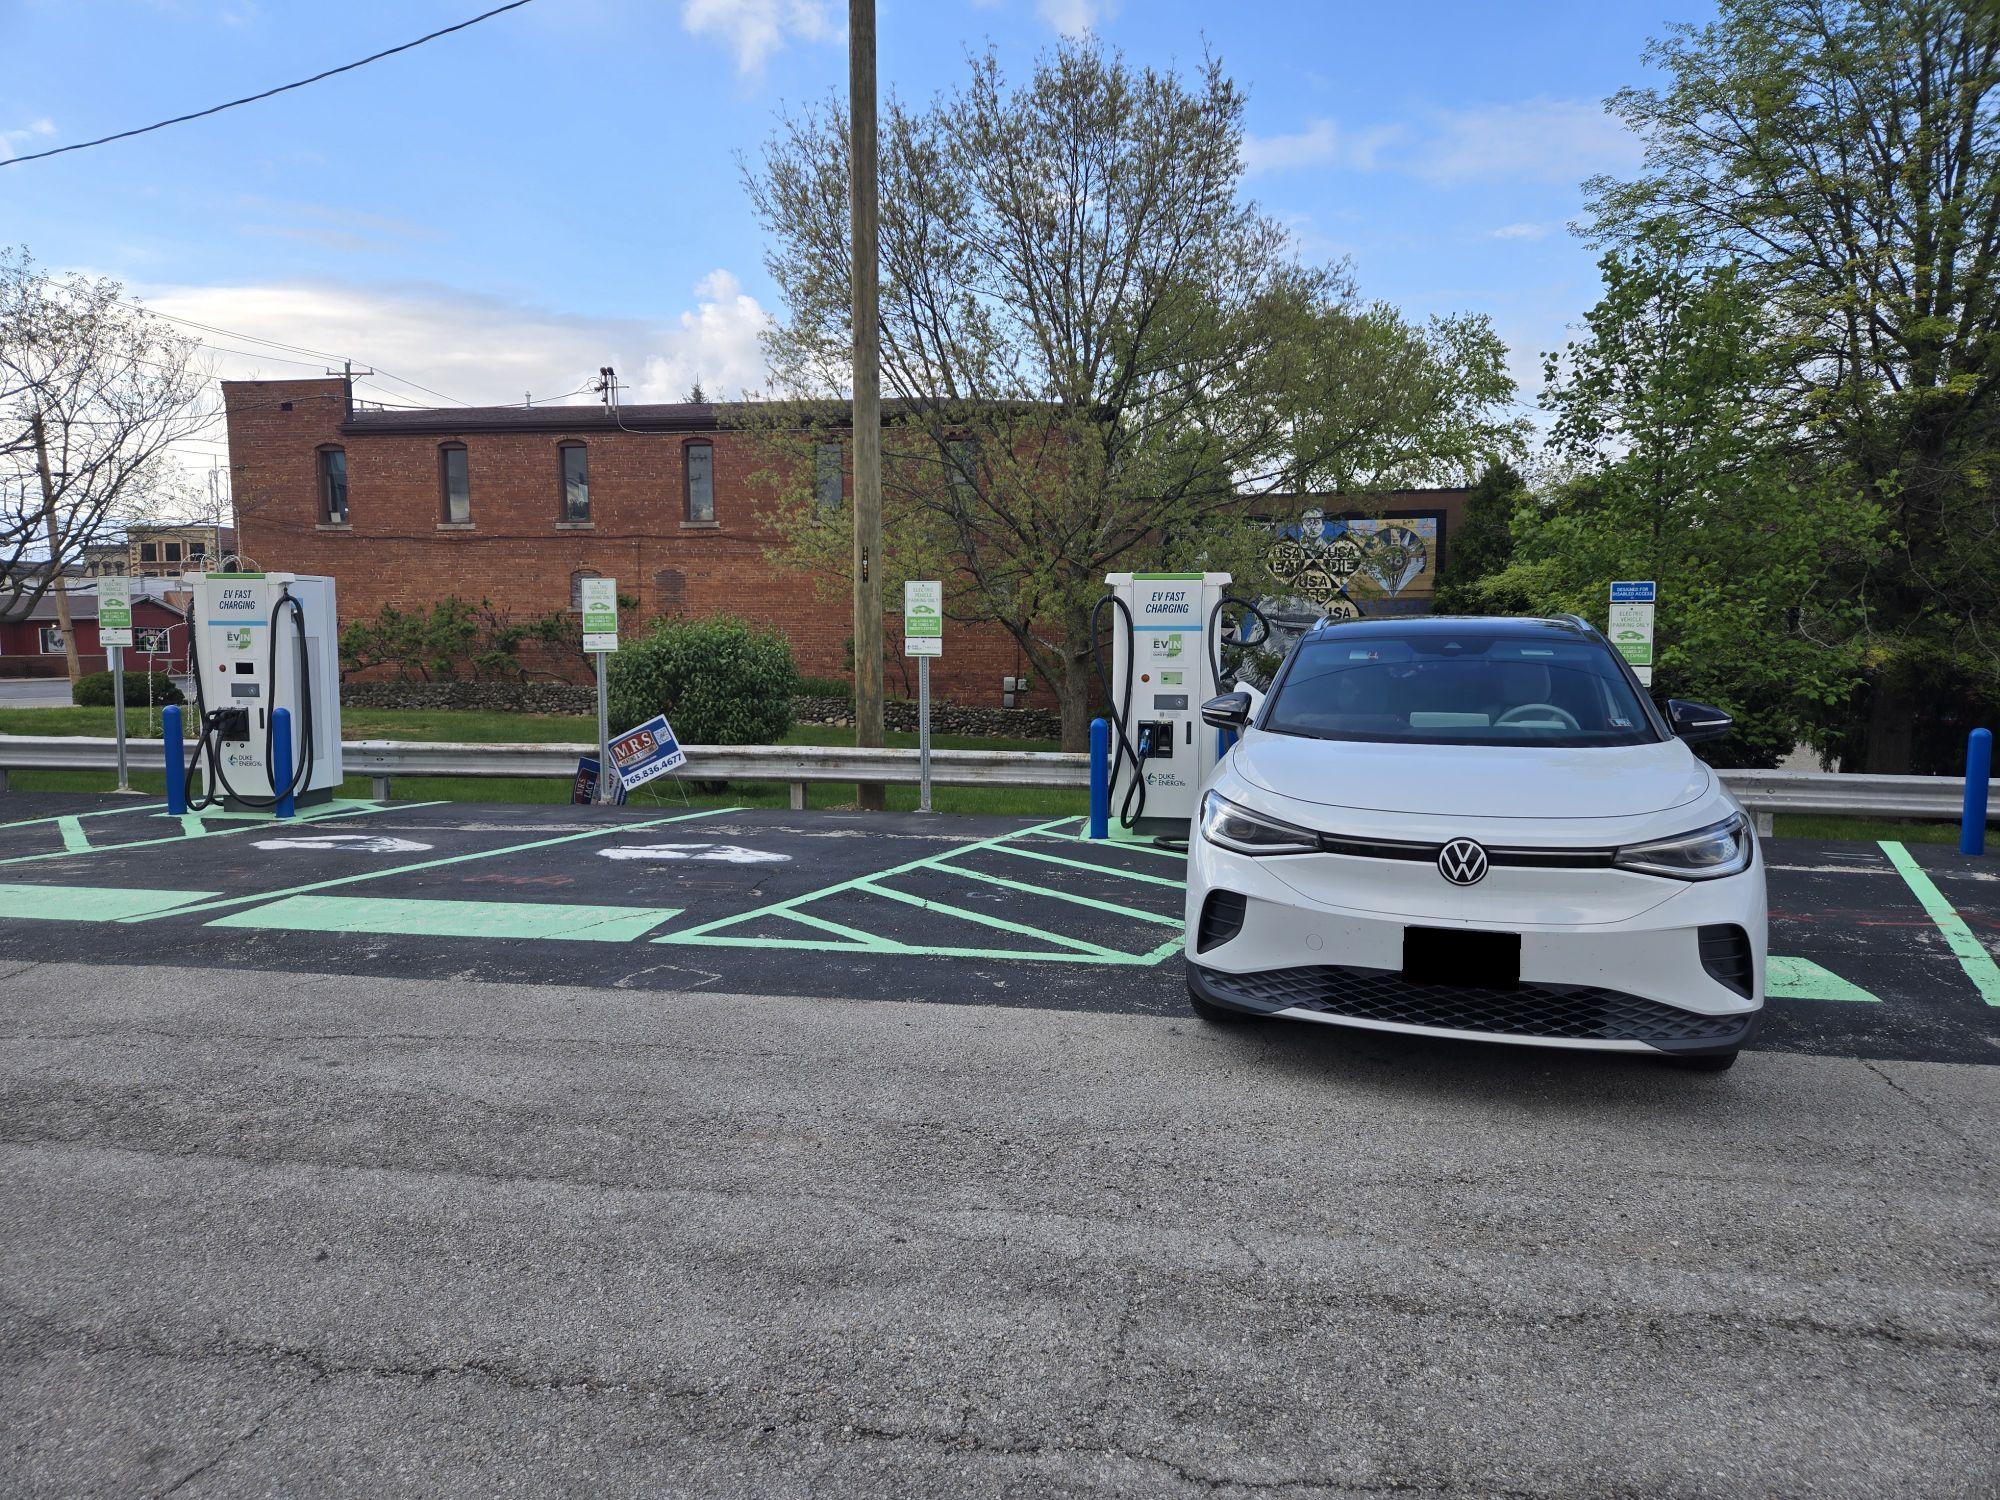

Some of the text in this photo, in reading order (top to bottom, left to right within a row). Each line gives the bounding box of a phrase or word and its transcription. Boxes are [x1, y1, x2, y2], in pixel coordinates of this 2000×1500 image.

[1328, 546, 1356, 558] USA
[1273, 560, 1301, 573] EAT
[1329, 560, 1355, 572] DIE
[1299, 575, 1328, 588] USA
[223, 589, 252, 599] EV FAST
[1151, 591, 1186, 602] EV FAST
[219, 600, 256, 610] CHARGING
[1145, 603, 1189, 614] CHARGING
[613, 732, 655, 760] M.R.S.
[624, 753, 682, 787] 765.836.4677
